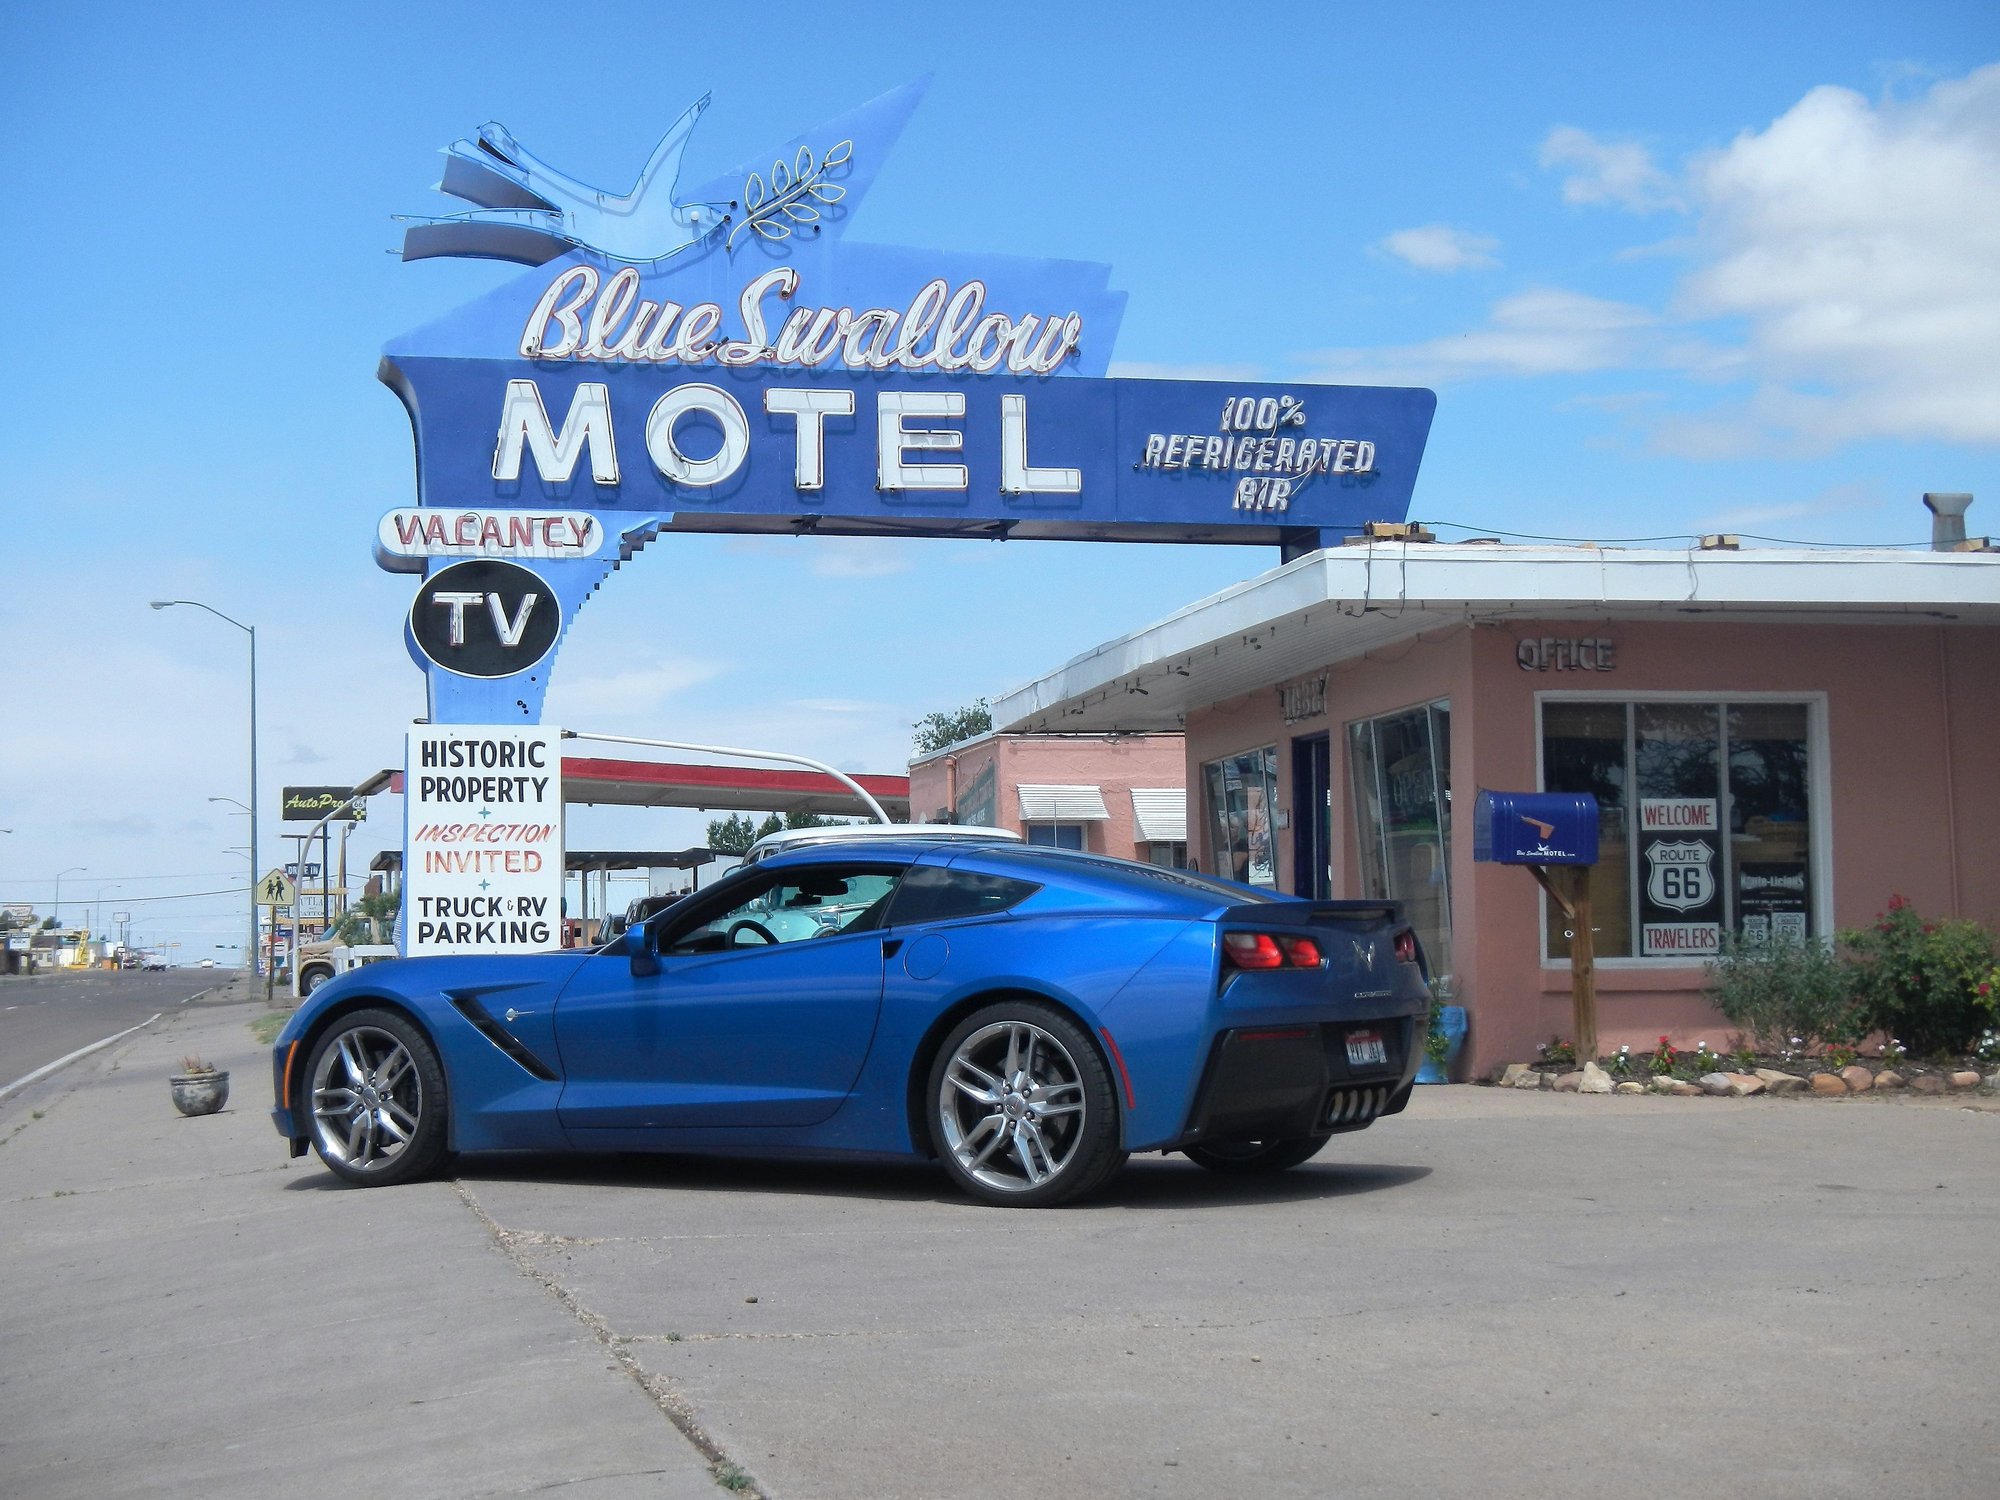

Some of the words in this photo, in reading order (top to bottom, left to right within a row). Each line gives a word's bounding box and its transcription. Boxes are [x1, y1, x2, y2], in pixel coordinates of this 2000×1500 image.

[520, 265, 721, 361] Blue
[718, 266, 1082, 374] Swallow
[1220, 395, 1306, 431] 100%
[491, 378, 1082, 494] MOTEL
[1143, 433, 1377, 473] REFRIGERATED
[1232, 476, 1292, 511] AIR
[394, 514, 593, 548] VACANCY
[432, 591, 538, 647] TV
[1516, 638, 1616, 672] OFFICE
[421, 740, 546, 768] HISTORIC
[420, 776, 549, 803] PROPERTY
[1644, 805, 1711, 826] WELCOME
[414, 823, 558, 844] INSPECTION
[425, 850, 543, 874] INVITED
[1659, 849, 1700, 861] ROUTE
[287, 865, 309, 875] DRE
[1662, 867, 1700, 899] 66
[417, 896, 503, 918] TRUCK
[506, 900, 513, 911] &
[516, 896, 548, 918] RV
[417, 921, 550, 944] PARKING
[1646, 927, 1716, 950] TRAVELERS
